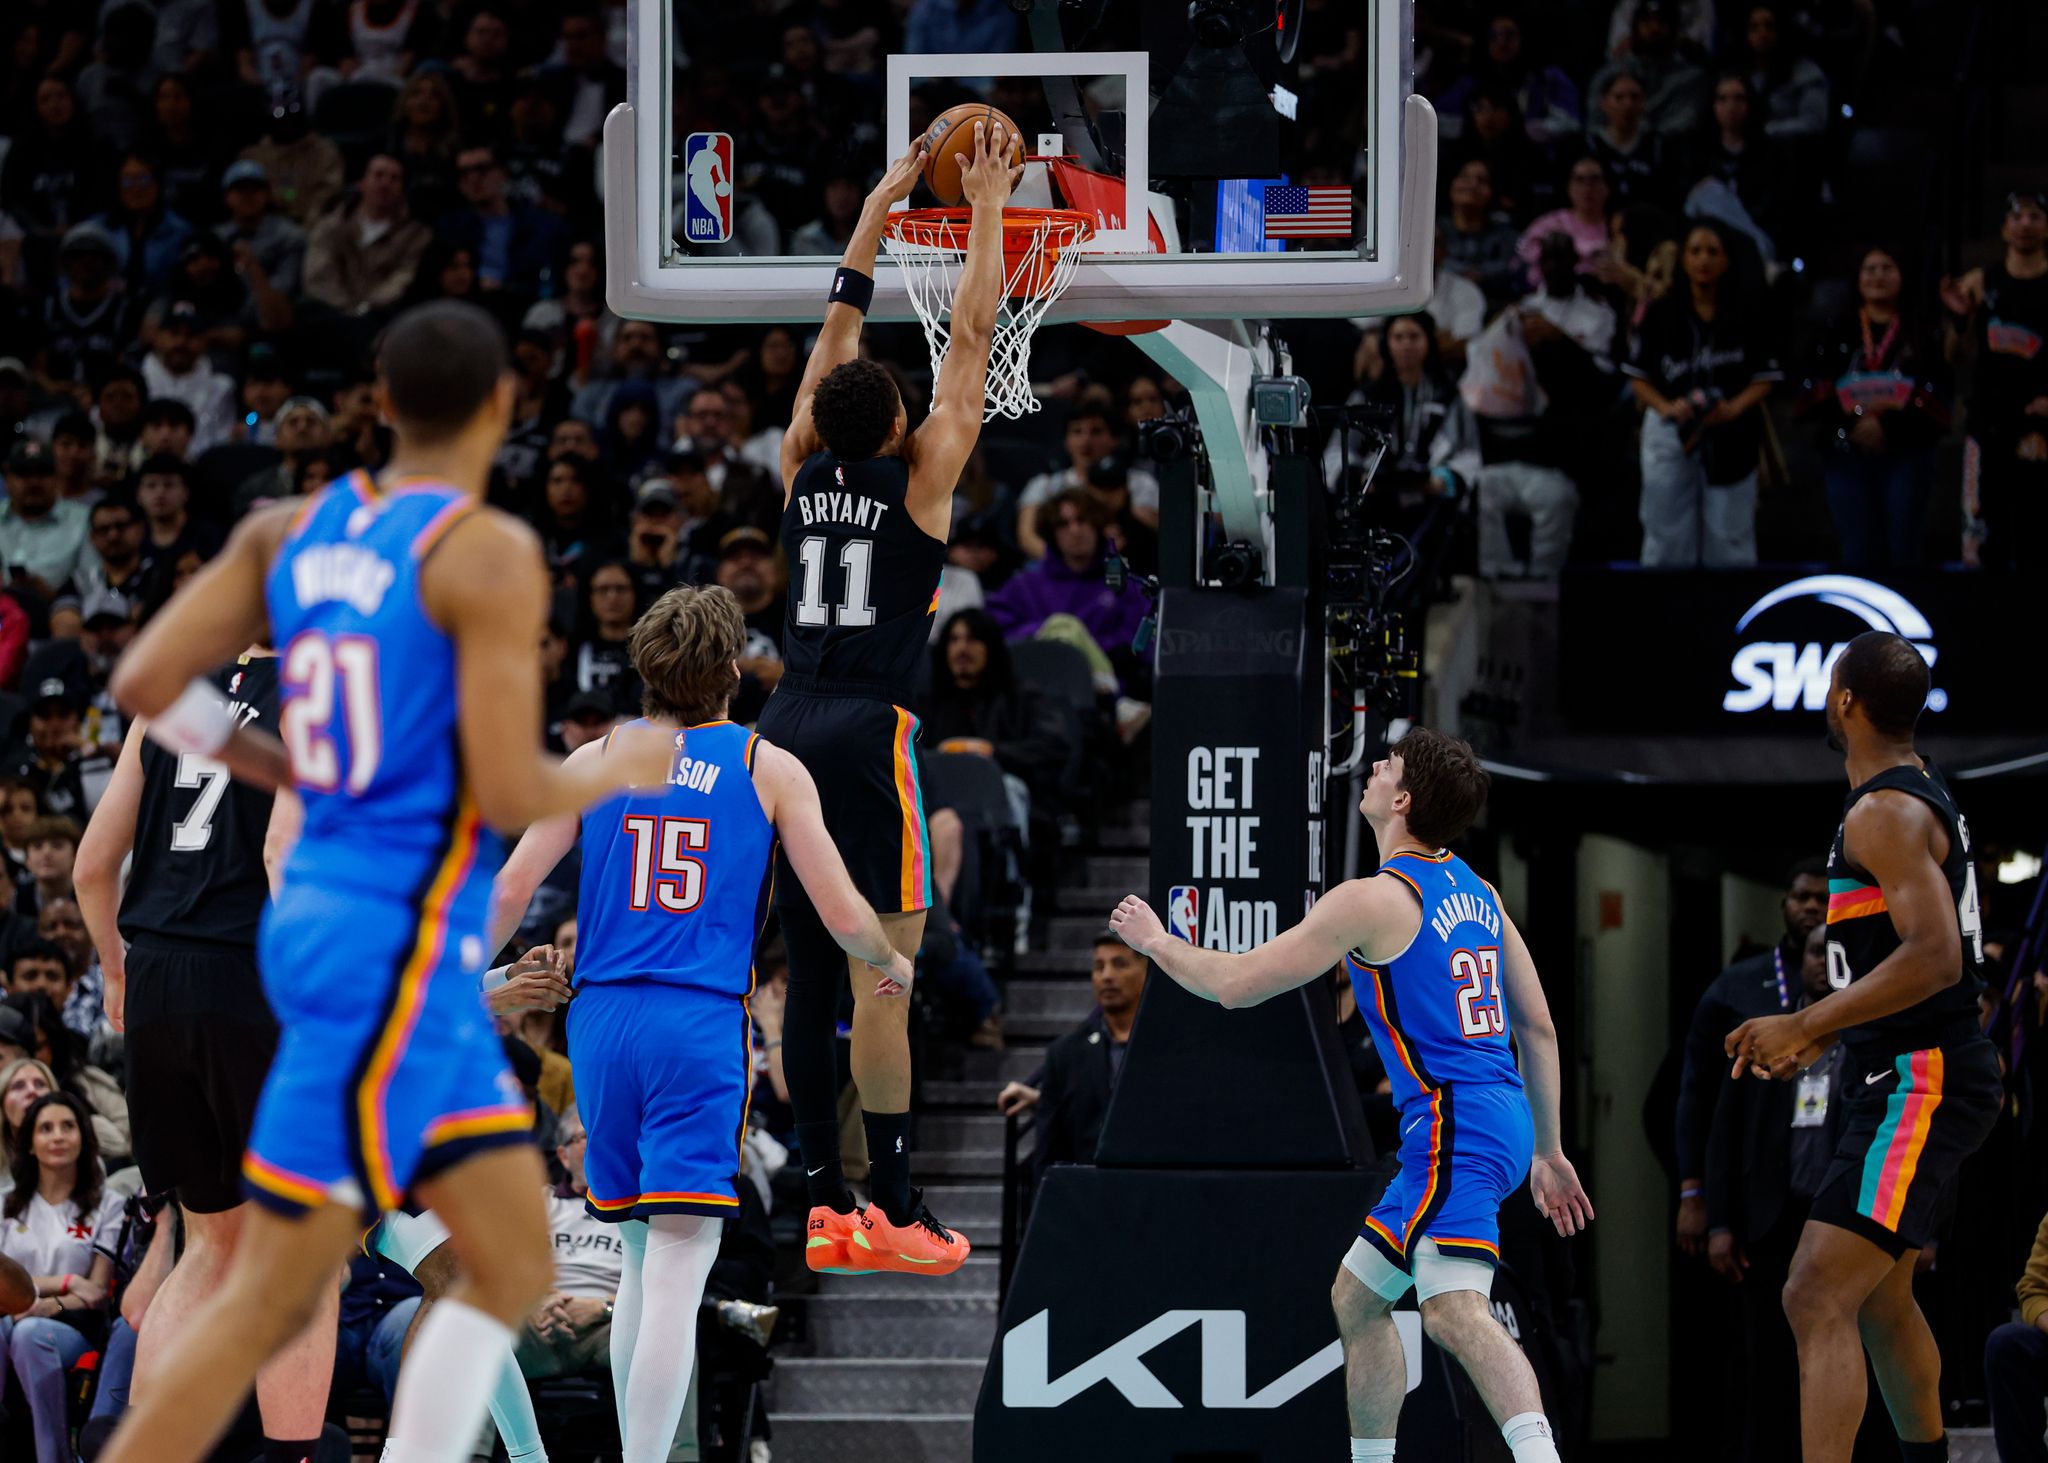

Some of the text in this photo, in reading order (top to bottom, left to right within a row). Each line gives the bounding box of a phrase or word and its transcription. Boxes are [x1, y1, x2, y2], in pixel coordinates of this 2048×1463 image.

[692, 218, 714, 235] NBA
[798, 492, 888, 531] BRYANT
[796, 536, 876, 626] 11
[282, 627, 385, 798] 21
[170, 749, 231, 851] 7
[666, 757, 721, 795] LSON
[1187, 746, 1260, 810] GET
[624, 814, 710, 914] 15
[1186, 816, 1261, 879] THE
[1431, 892, 1500, 943] BARNHIZER
[1450, 946, 1505, 1039] 23
[809, 1219, 825, 1231] 23
[860, 1215, 875, 1231] 23
